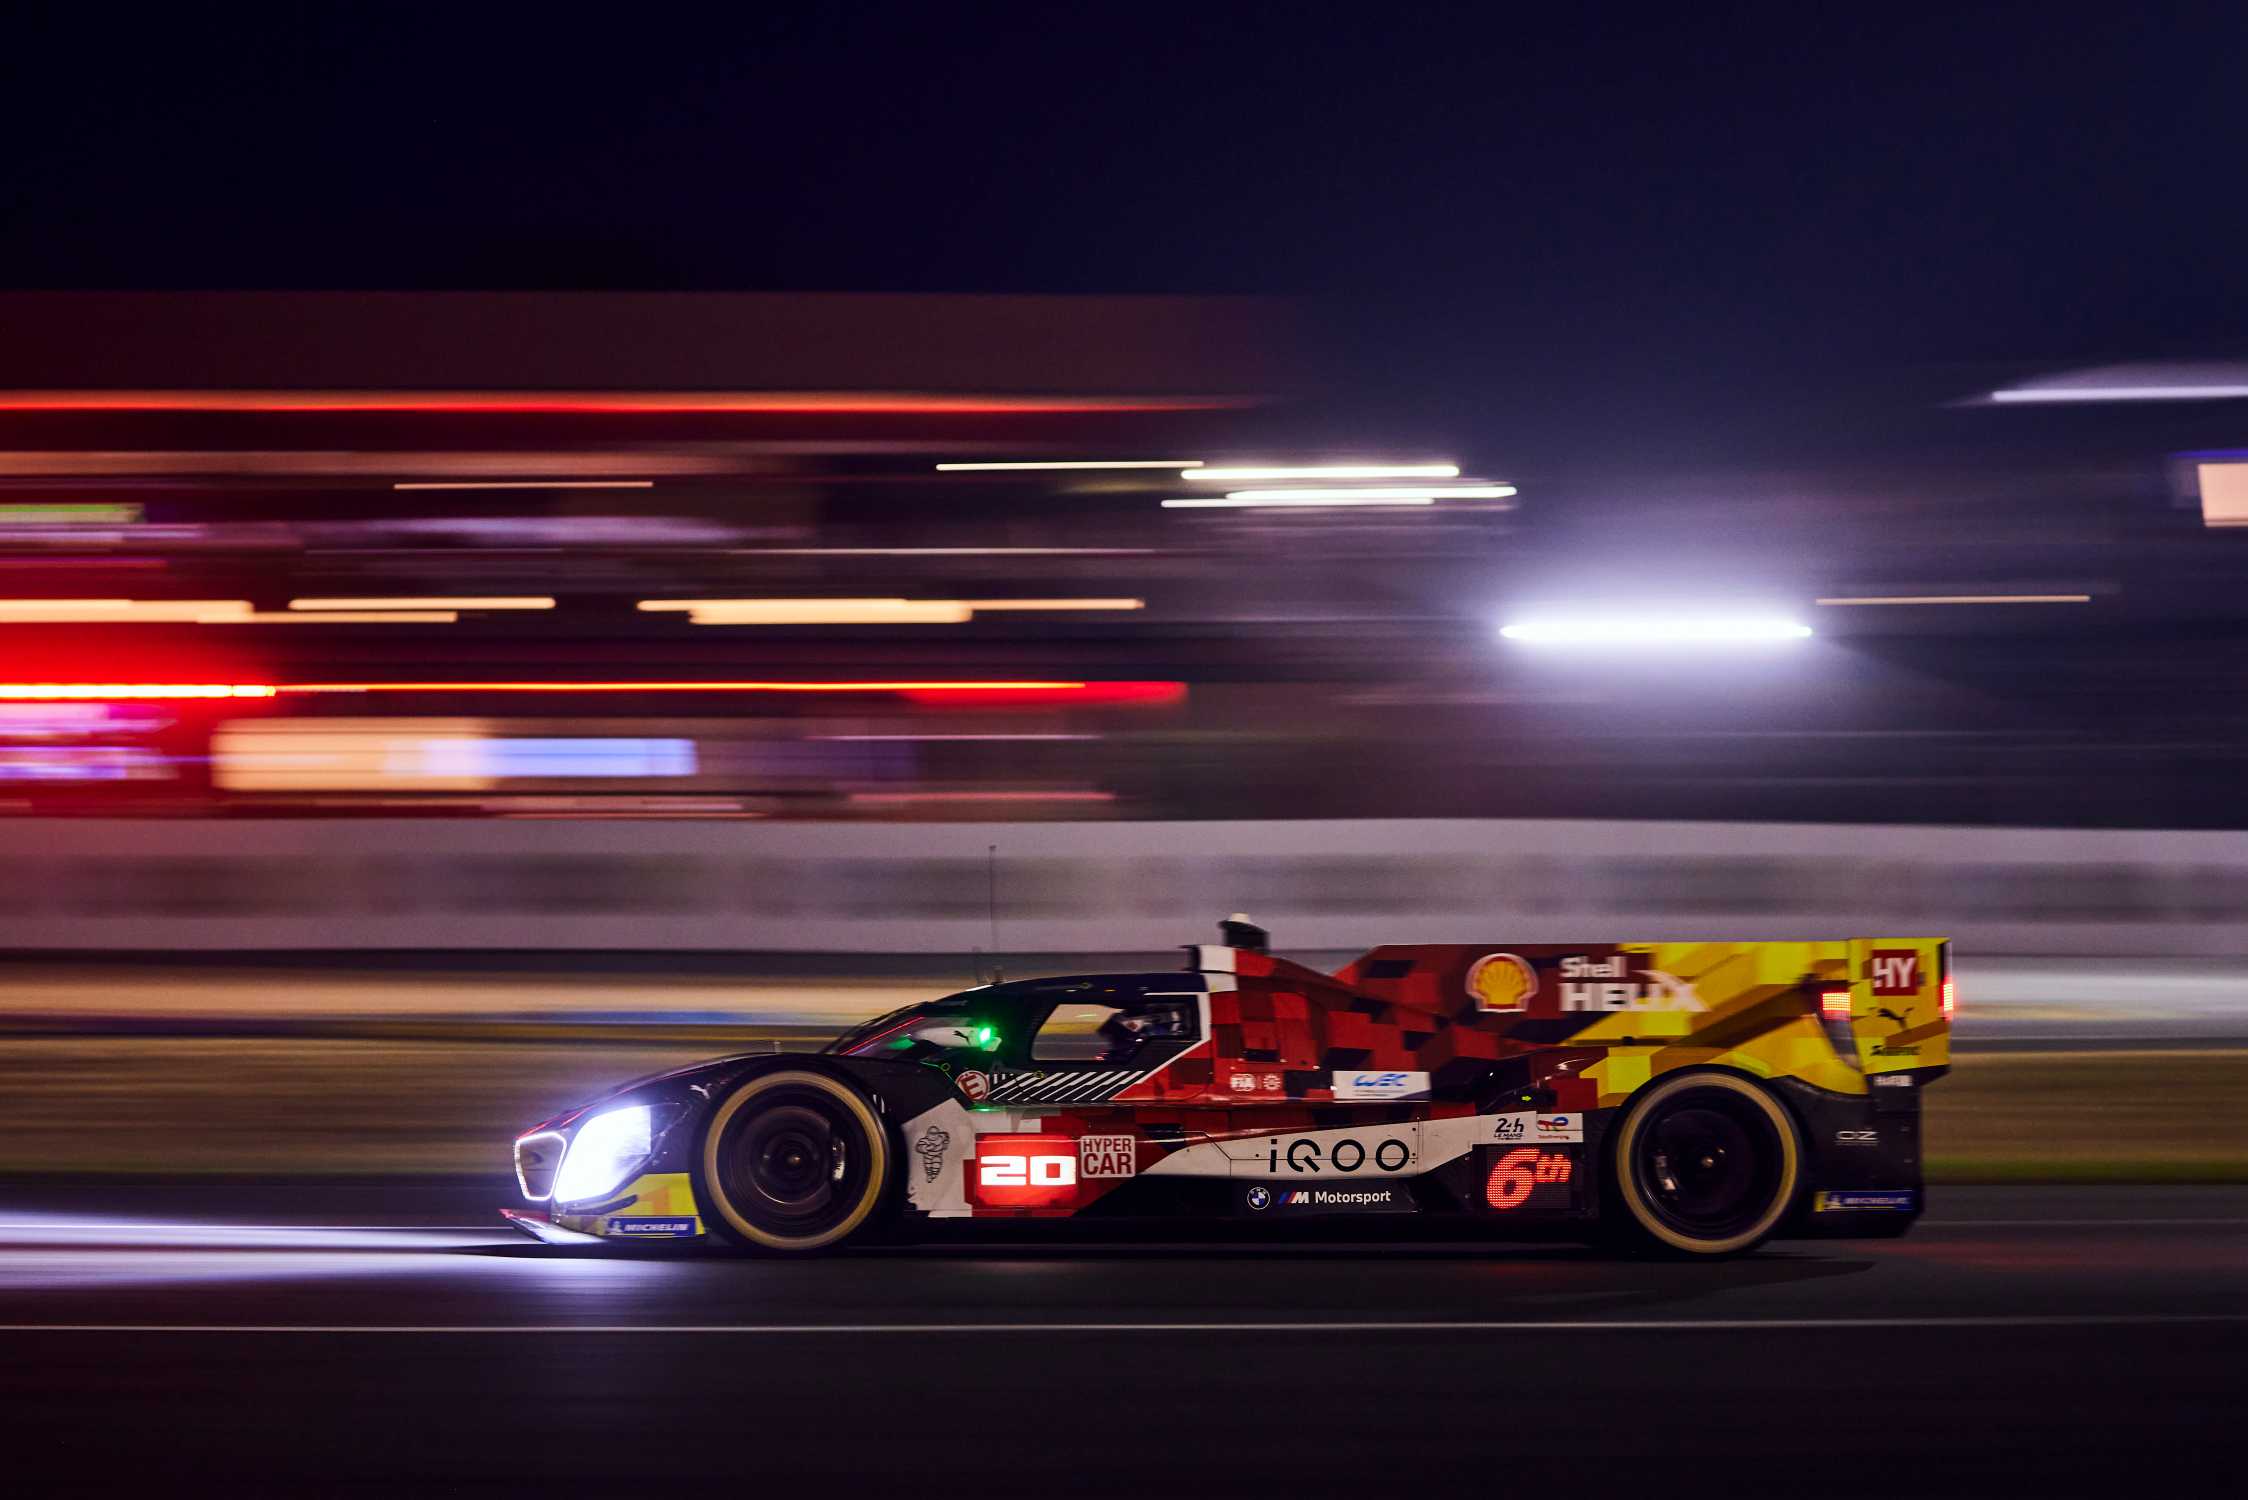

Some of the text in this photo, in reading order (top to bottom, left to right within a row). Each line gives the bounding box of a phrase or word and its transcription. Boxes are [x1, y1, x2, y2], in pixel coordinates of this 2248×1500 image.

[1559, 956, 1627, 978] Shell
[1873, 957, 1916, 989] HY
[1559, 970, 1711, 1012] HELIX
[1083, 1138, 1132, 1153] HYPER
[980, 1155, 1077, 1187] 20
[1083, 1152, 1132, 1175] CAR
[1486, 1148, 1572, 1209] 6th
[1315, 1190, 1392, 1205] Motorsport
